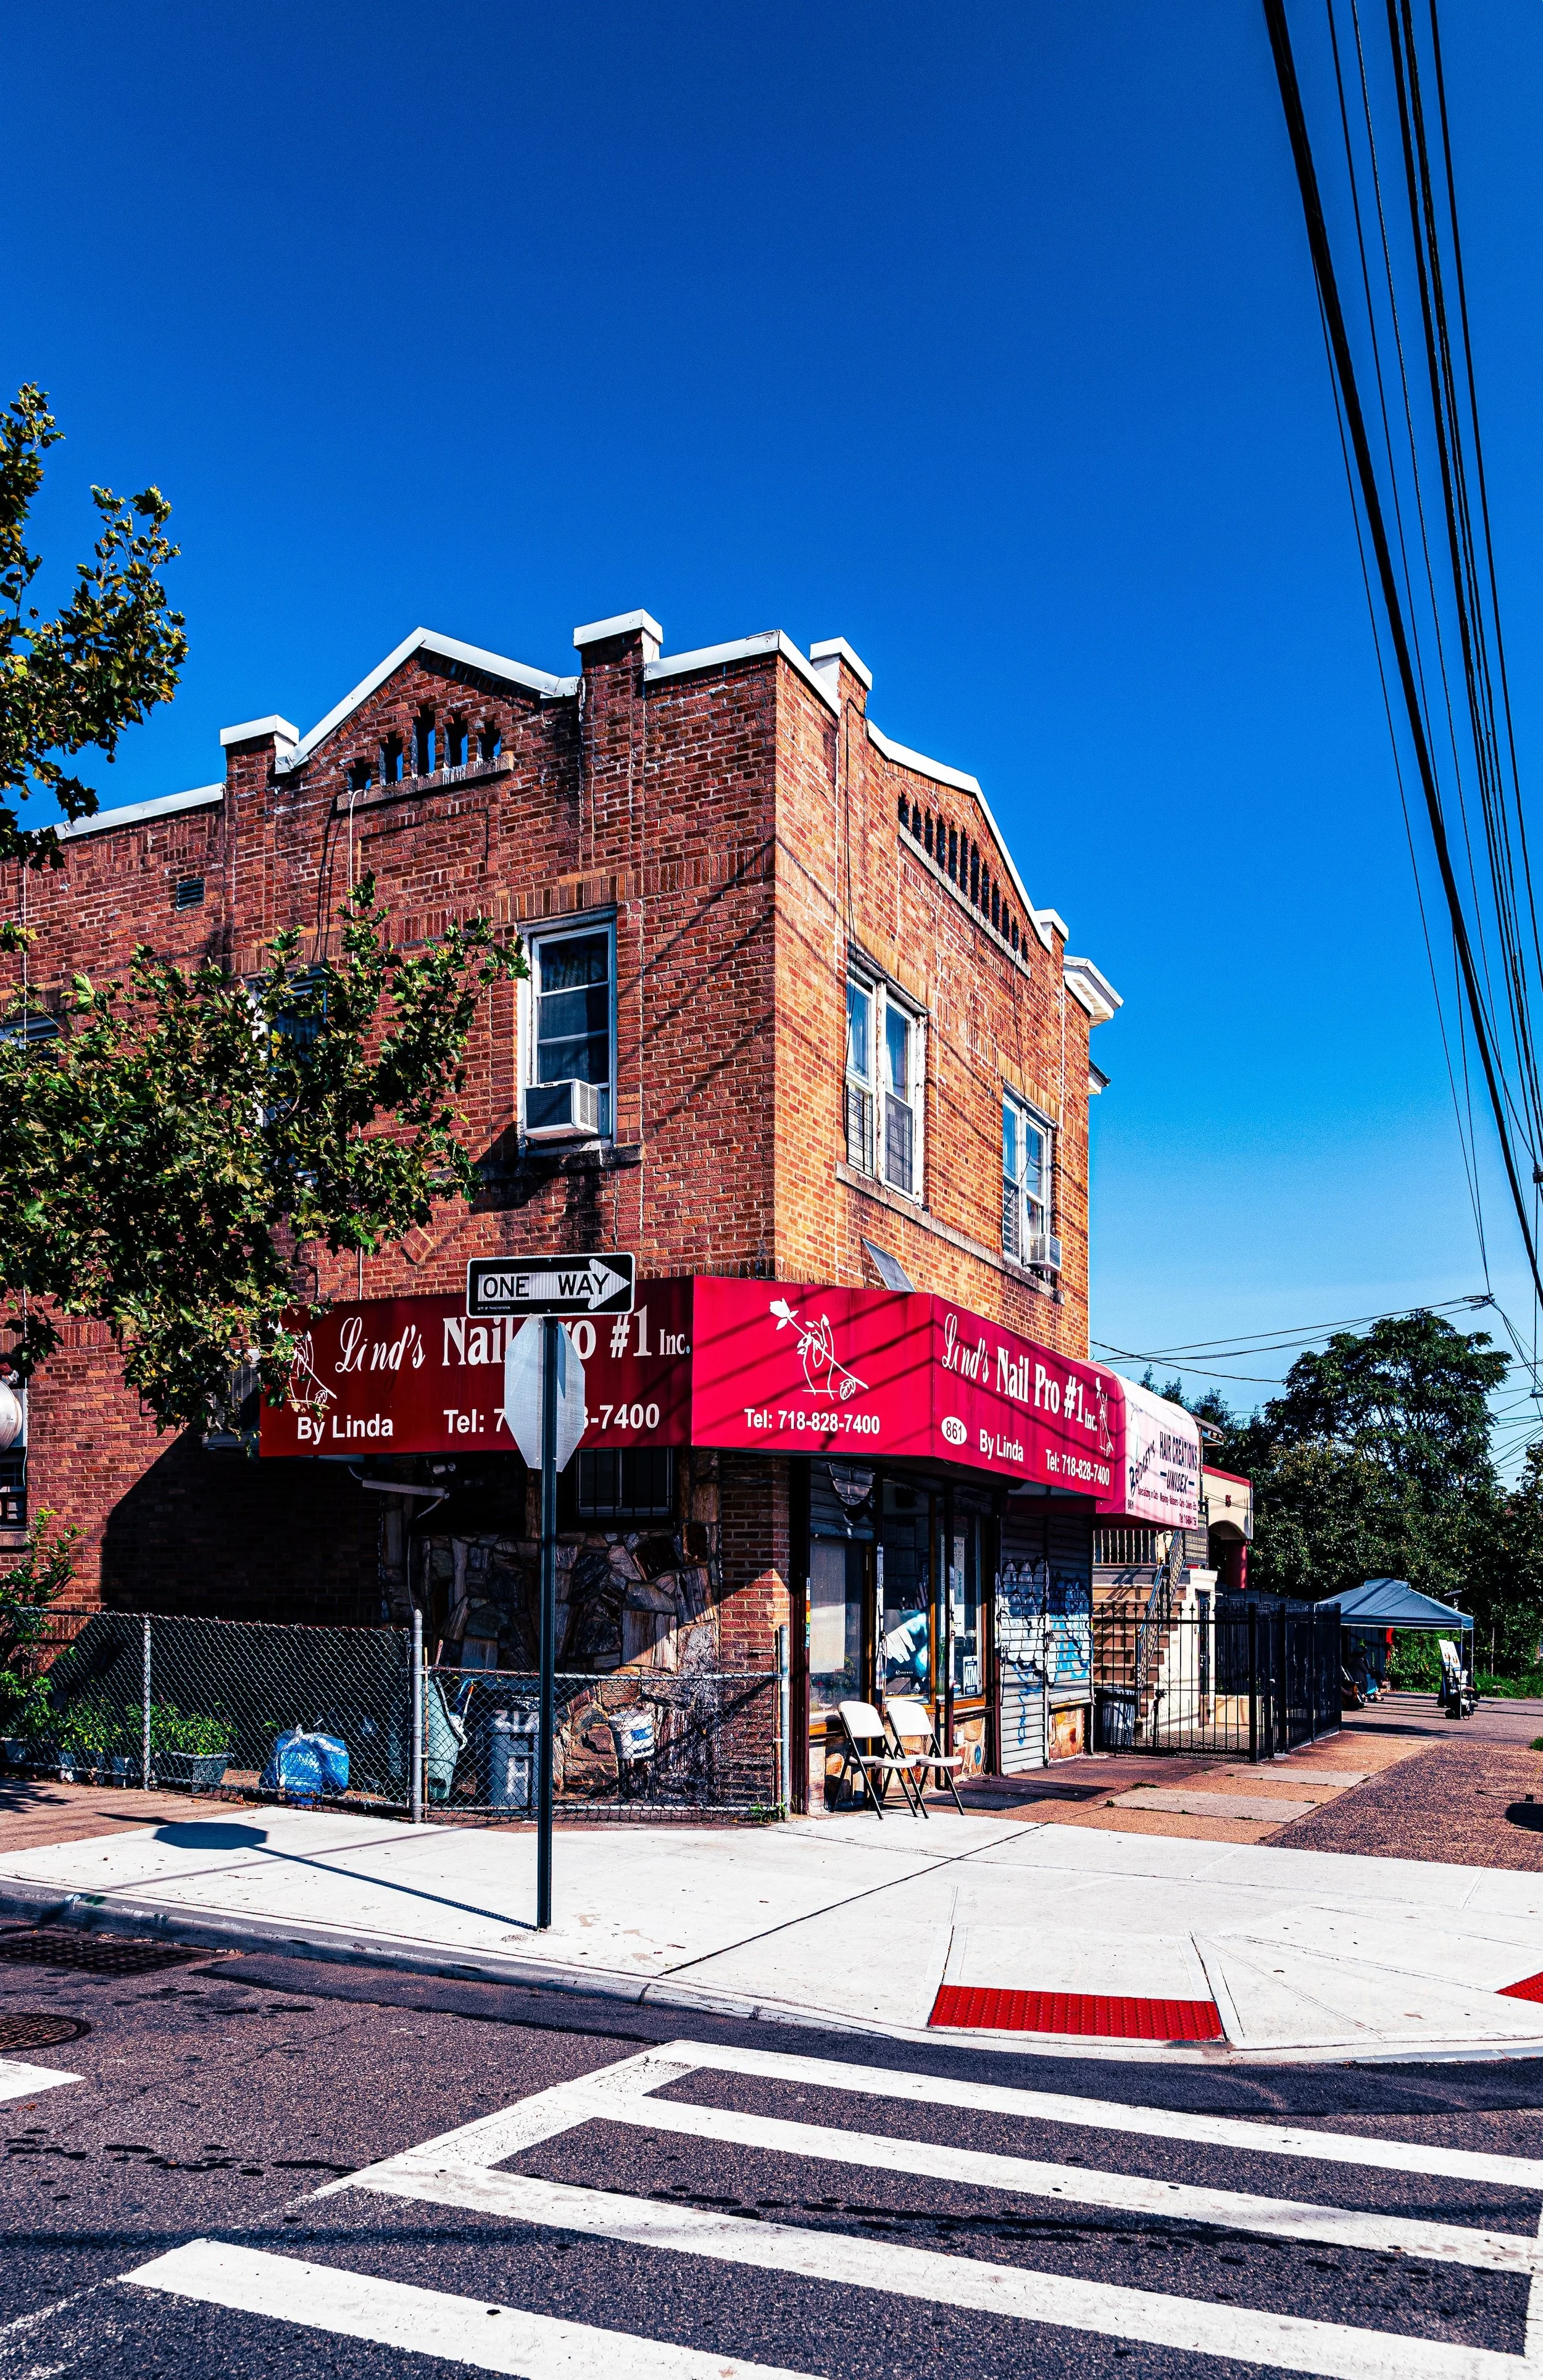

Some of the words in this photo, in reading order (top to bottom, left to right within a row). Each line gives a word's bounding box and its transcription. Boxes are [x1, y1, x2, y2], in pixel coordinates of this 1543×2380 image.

[483, 1275, 530, 1299] ONE
[558, 1273, 610, 1296] WAY
[659, 1329, 690, 1355] Inc.
[996, 1346, 1029, 1403] Nail
[1034, 1363, 1060, 1414] Pro
[1063, 1375, 1084, 1423] #1
[1084, 1408, 1097, 1431] Inc.
[297, 1417, 325, 1445] By
[332, 1413, 393, 1438] Linda
[443, 1408, 485, 1433] Tel:
[744, 1408, 773, 1428] Tel:
[778, 1410, 880, 1434] 718-828-7400
[946, 1420, 963, 1442] 861
[979, 1428, 994, 1460] By
[997, 1434, 1023, 1462] Linda
[1046, 1449, 1060, 1472] Tel:
[1062, 1454, 1110, 1486] 718-828-7400
[1160, 1431, 1171, 1463] HAIR
[1172, 1436, 1197, 1471] CREATIONS
[1167, 1469, 1188, 1494] UNISEX
[965, 1665, 977, 1687] ATM
